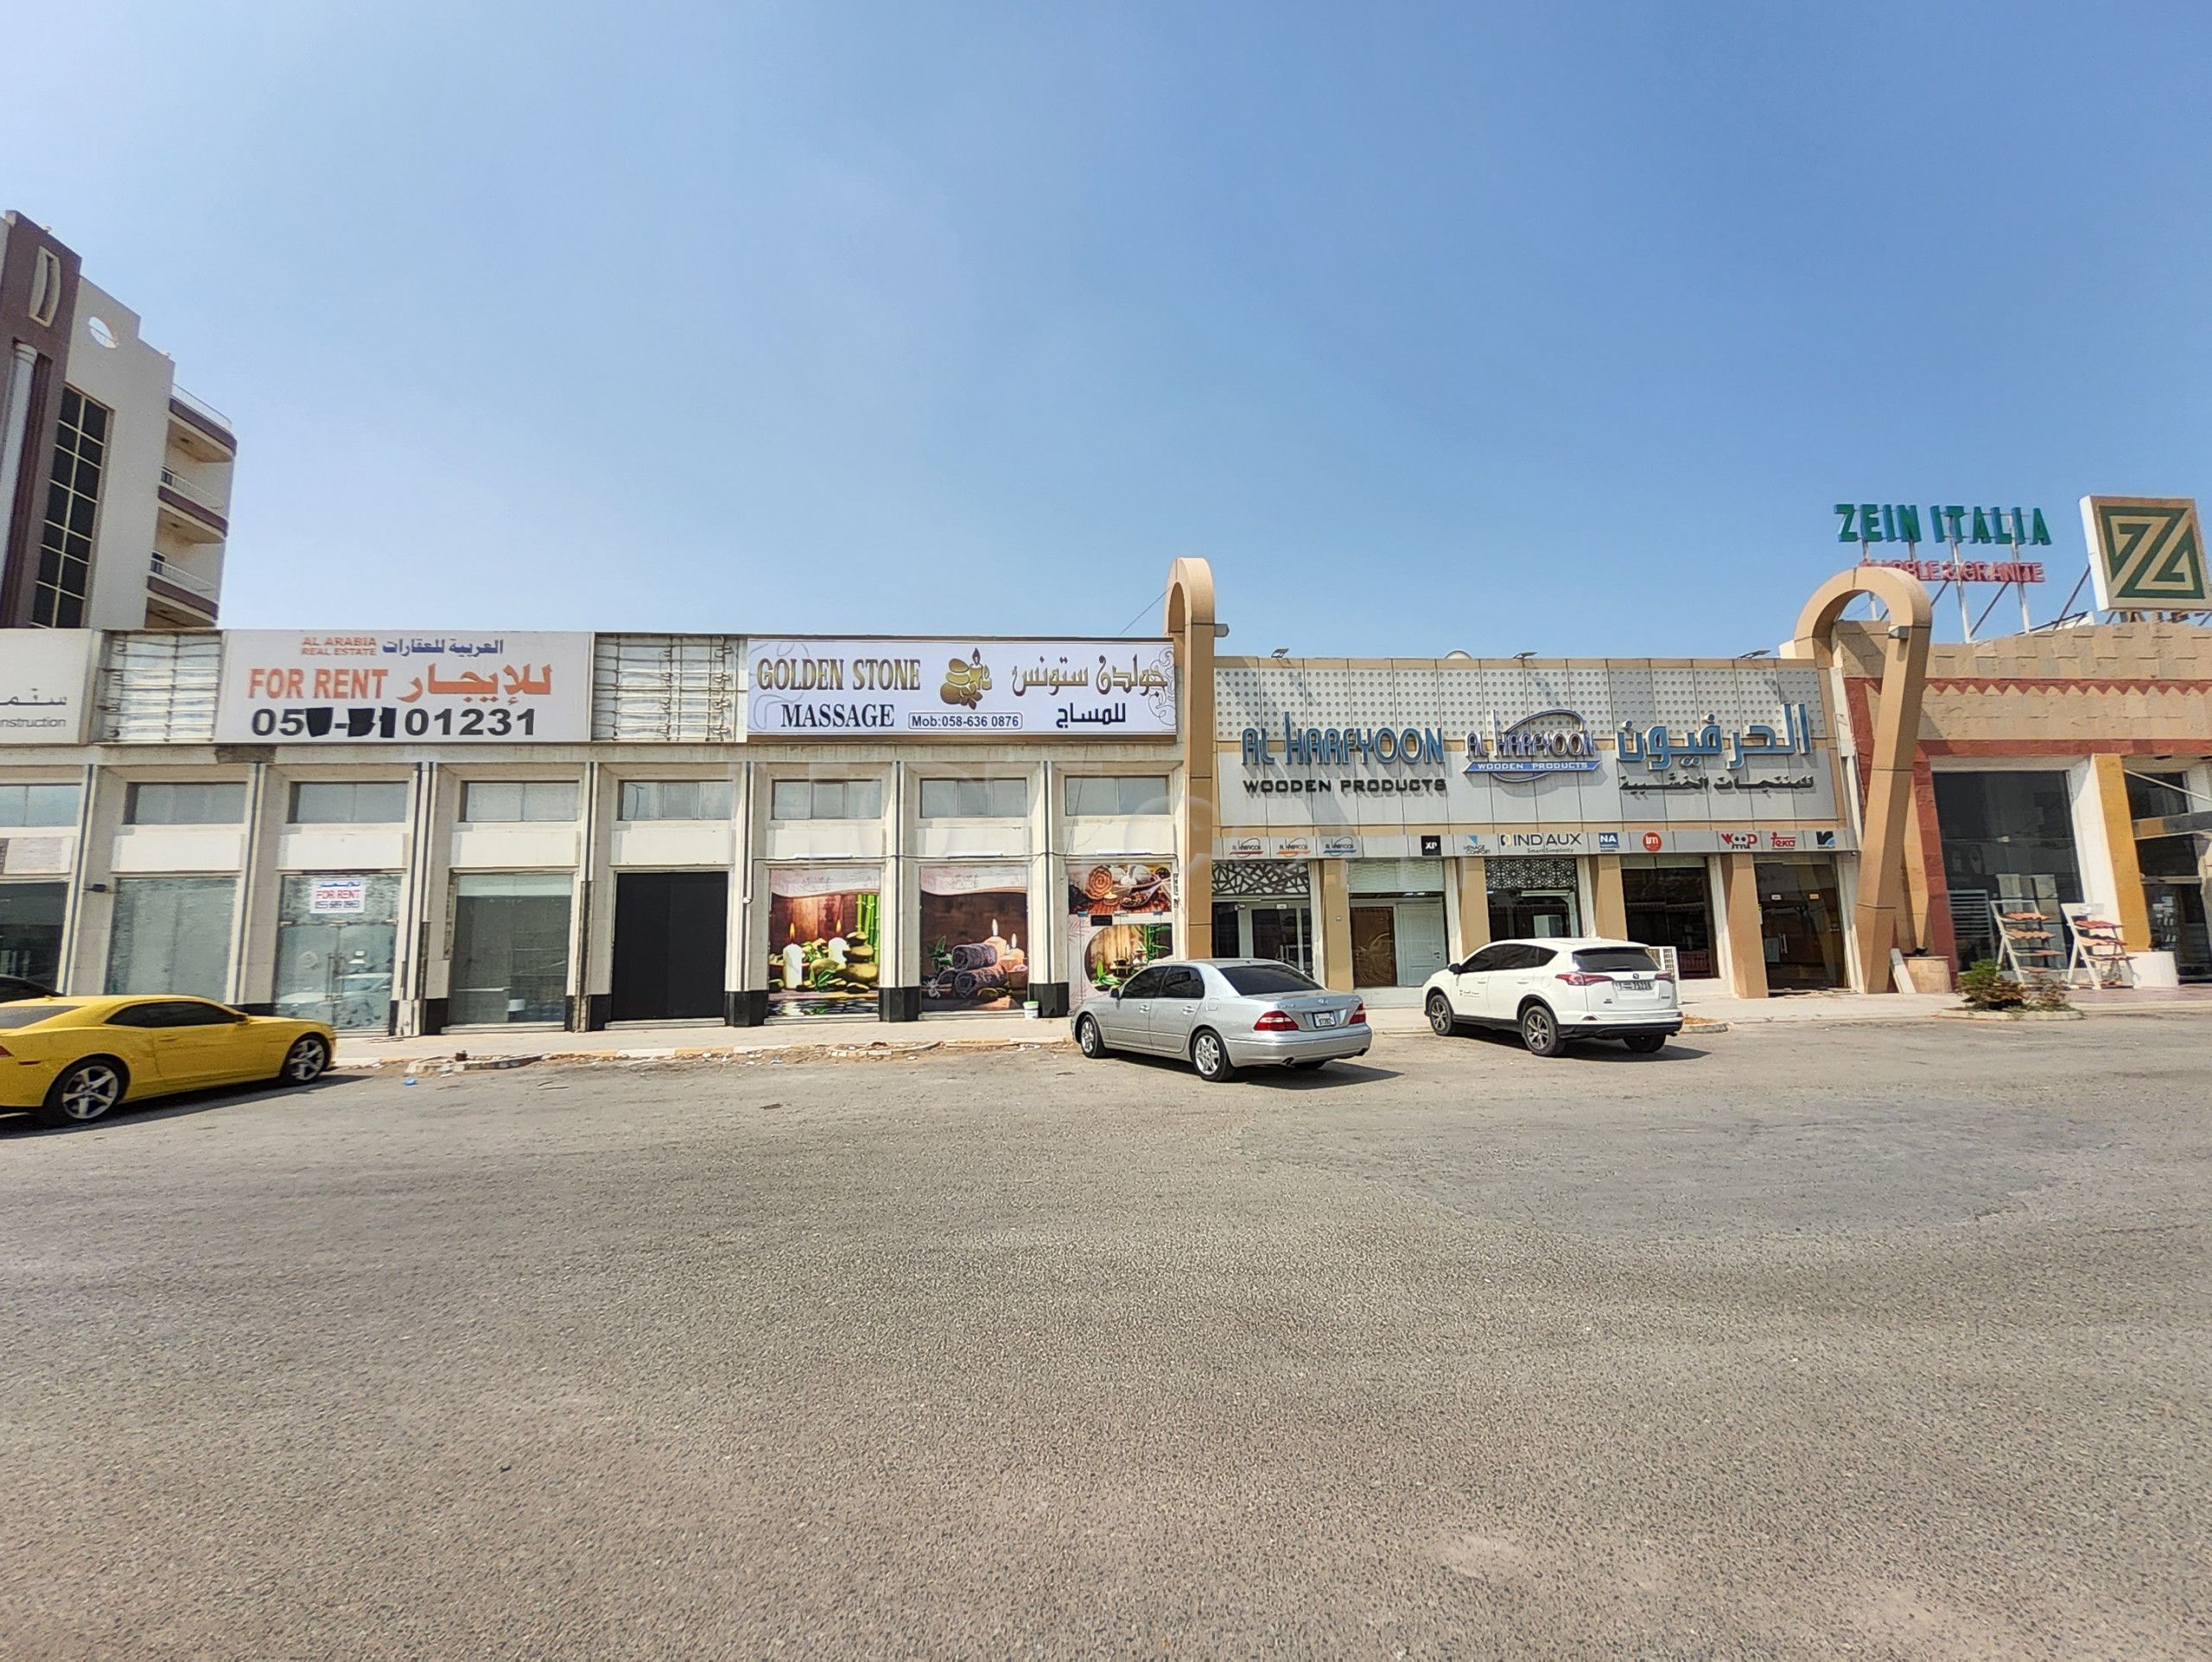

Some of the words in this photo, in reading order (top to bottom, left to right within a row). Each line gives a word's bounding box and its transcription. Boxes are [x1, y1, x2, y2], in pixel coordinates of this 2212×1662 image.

[1834, 504, 1922, 543] ZEIN
[1930, 505, 2052, 545] ITALIA
[1859, 559, 1941, 582] BLE
[1960, 562, 2045, 583] GRANITE
[302, 637, 321, 647] AL
[324, 637, 378, 647] ARABIA
[381, 638, 445, 657] للعقارات
[448, 638, 504, 658] العربية
[248, 668, 304, 699] FOR
[313, 668, 389, 699] RENT
[396, 662, 553, 705] للإيجار
[757, 658, 844, 691] GOLDEN
[852, 658, 921, 691] STONE
[1012, 655, 1089, 697] ستونس
[1096, 654, 1169, 697] جولدن
[0, 716, 67, 728] nstruction
[251, 707, 535, 738] 05-01231
[780, 703, 895, 729] MASSAGE
[991, 715, 1020, 728] 0876
[1056, 702, 1127, 729] للمساج
[1242, 728, 1275, 765] AL
[1284, 711, 1446, 766] HARFYOON
[1467, 732, 1489, 758] AL
[1616, 703, 1813, 770] الحرفيون
[1243, 779, 1332, 793] WOODEN
[1340, 779, 1446, 793] PRODUCTS
[1619, 773, 1709, 795] الخشبية
[1599, 834, 1617, 843] NA
